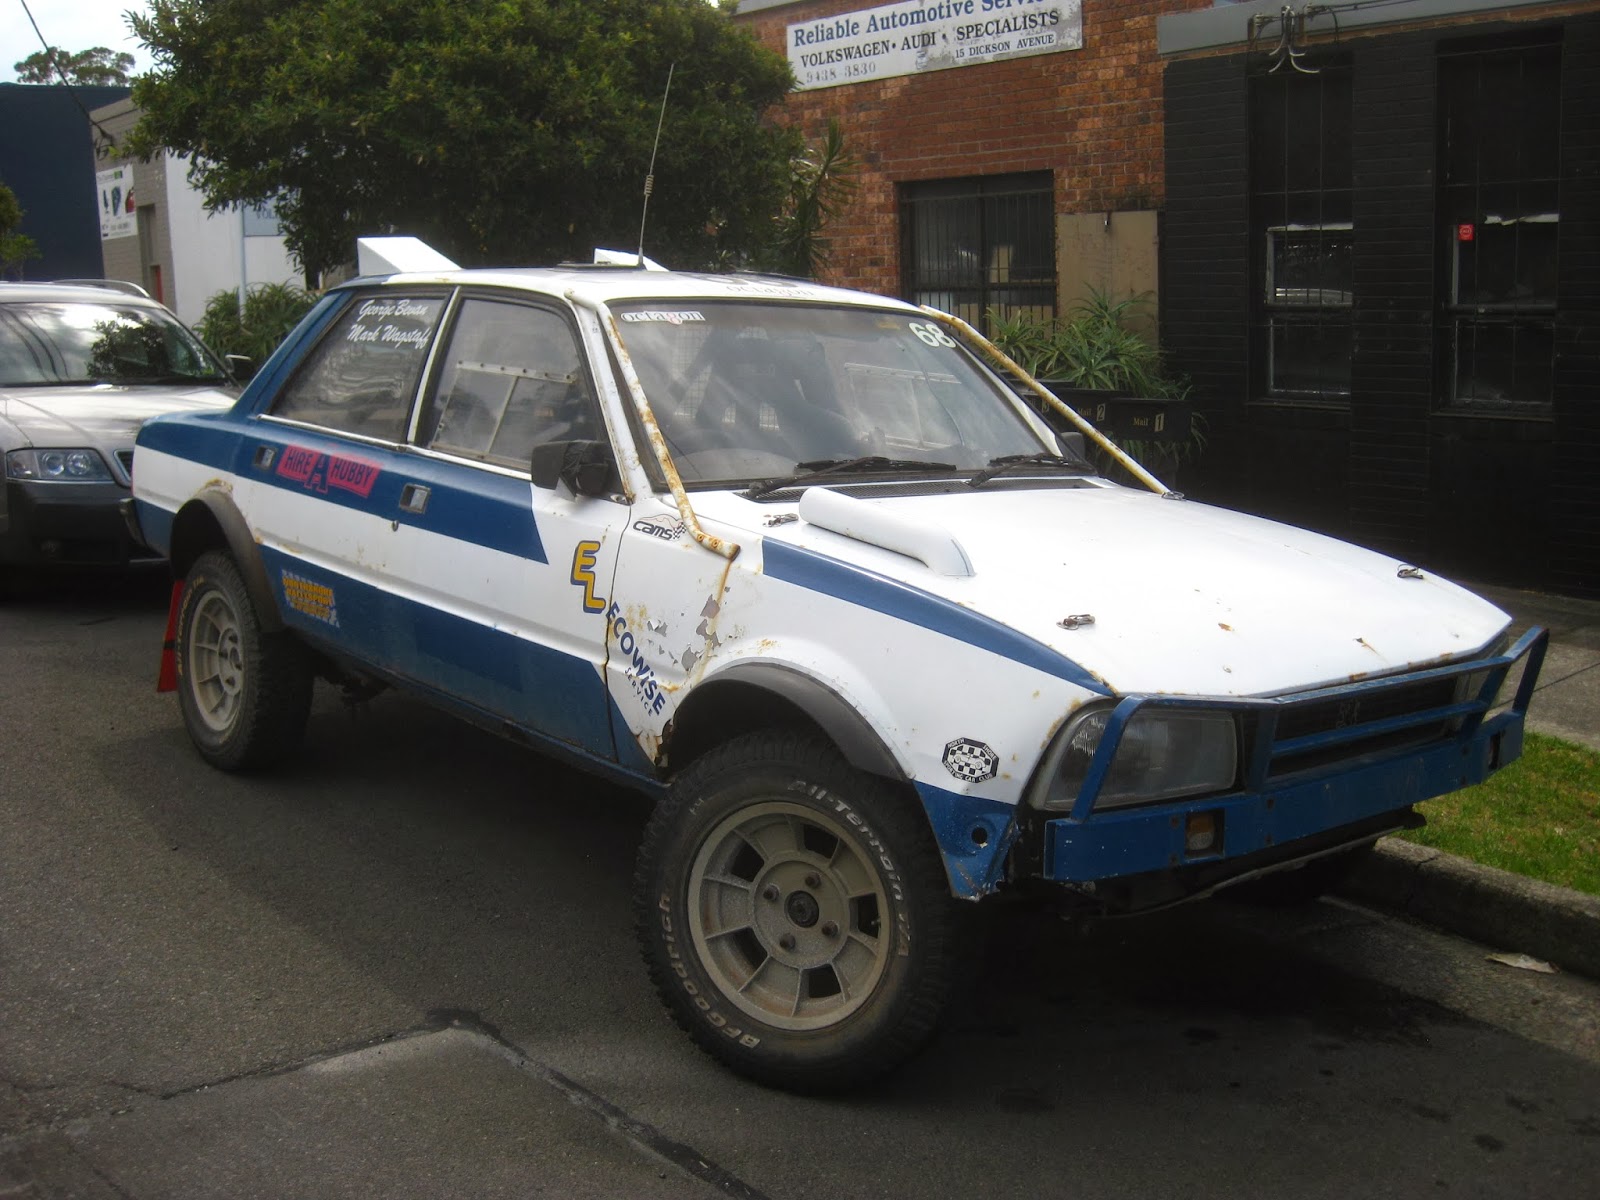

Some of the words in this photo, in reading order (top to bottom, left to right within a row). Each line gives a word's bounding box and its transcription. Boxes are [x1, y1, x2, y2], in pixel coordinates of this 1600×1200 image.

[794, 21, 860, 47] Reliable
[867, 0, 974, 33] Automotive
[981, 0, 1044, 11] Serv
[800, 41, 890, 68] VOLKSWAGEN
[902, 31, 936, 50] AUDI
[956, 11, 1059, 40] SPECIALISTS
[955, 48, 966, 58] 15
[969, 41, 1011, 57] DICKSON
[1016, 34, 1055, 49] AVENUE
[622, 311, 704, 324] octagon
[347, 324, 382, 342] Mark
[908, 322, 957, 348] 68
[1098, 404, 1105, 420] 2
[1133, 418, 1148, 426] Mail
[1156, 415, 1163, 432] 1
[285, 448, 313, 475] HIRE
[305, 453, 331, 494] A
[331, 457, 374, 488] HUBBY
[633, 520, 673, 541] cams
